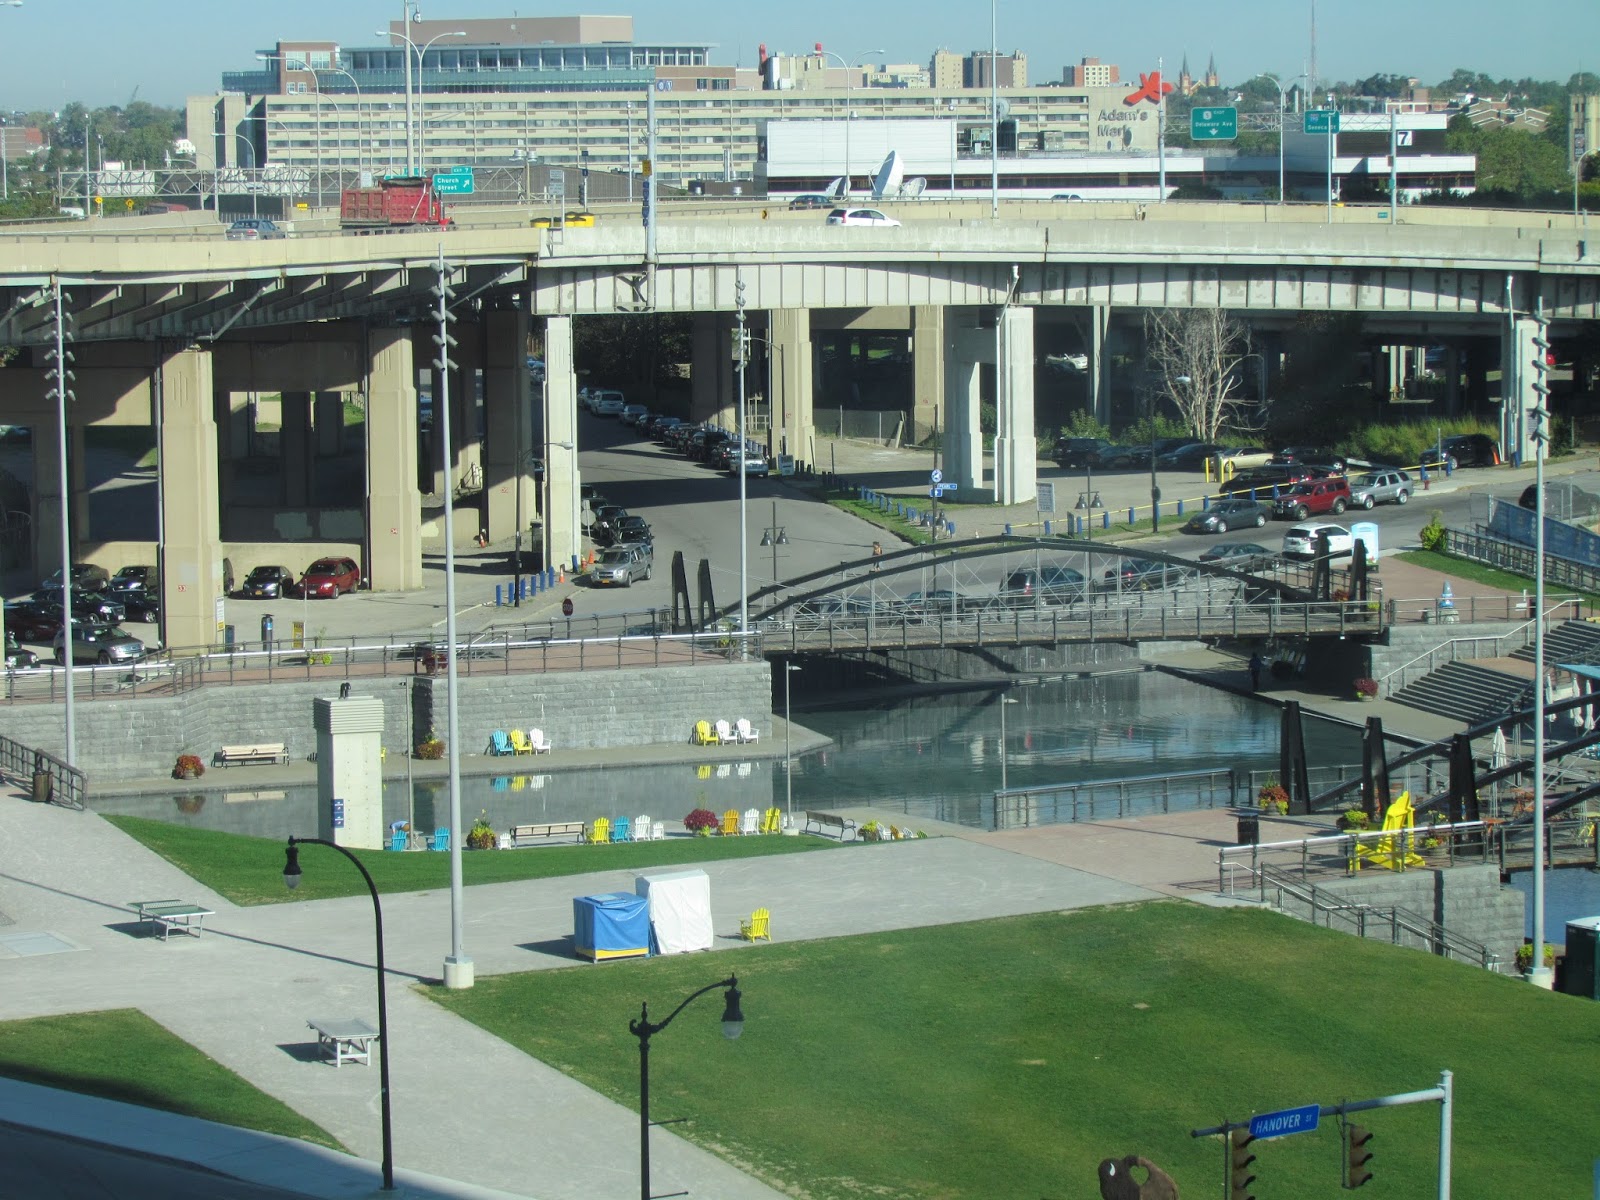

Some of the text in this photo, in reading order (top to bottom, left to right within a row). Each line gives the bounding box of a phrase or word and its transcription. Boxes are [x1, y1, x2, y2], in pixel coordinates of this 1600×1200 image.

[1098, 109, 1148, 121] Adam's
[1398, 131, 1409, 145] 7
[1255, 1114, 1300, 1134] HANOVER
